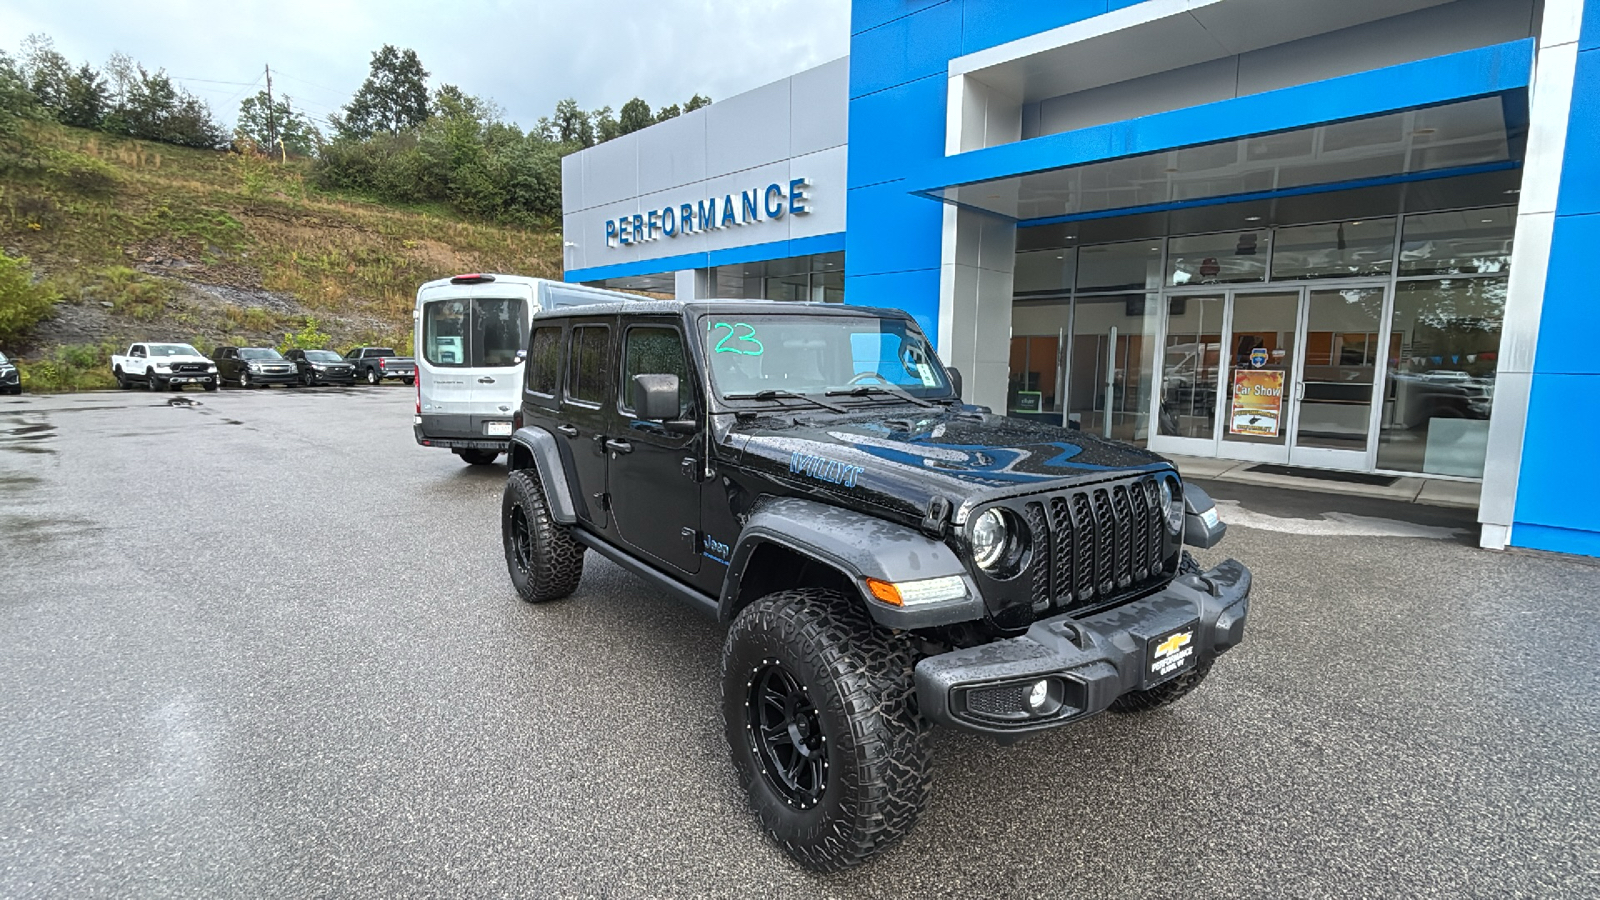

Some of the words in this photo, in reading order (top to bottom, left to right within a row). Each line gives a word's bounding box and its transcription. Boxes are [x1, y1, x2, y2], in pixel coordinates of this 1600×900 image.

[605, 177, 811, 248] PERFORMANCE
[1235, 384, 1251, 396] Car
[1254, 384, 1281, 397] Show
[789, 451, 865, 488] WILLYS
[703, 534, 730, 559] Jeep
